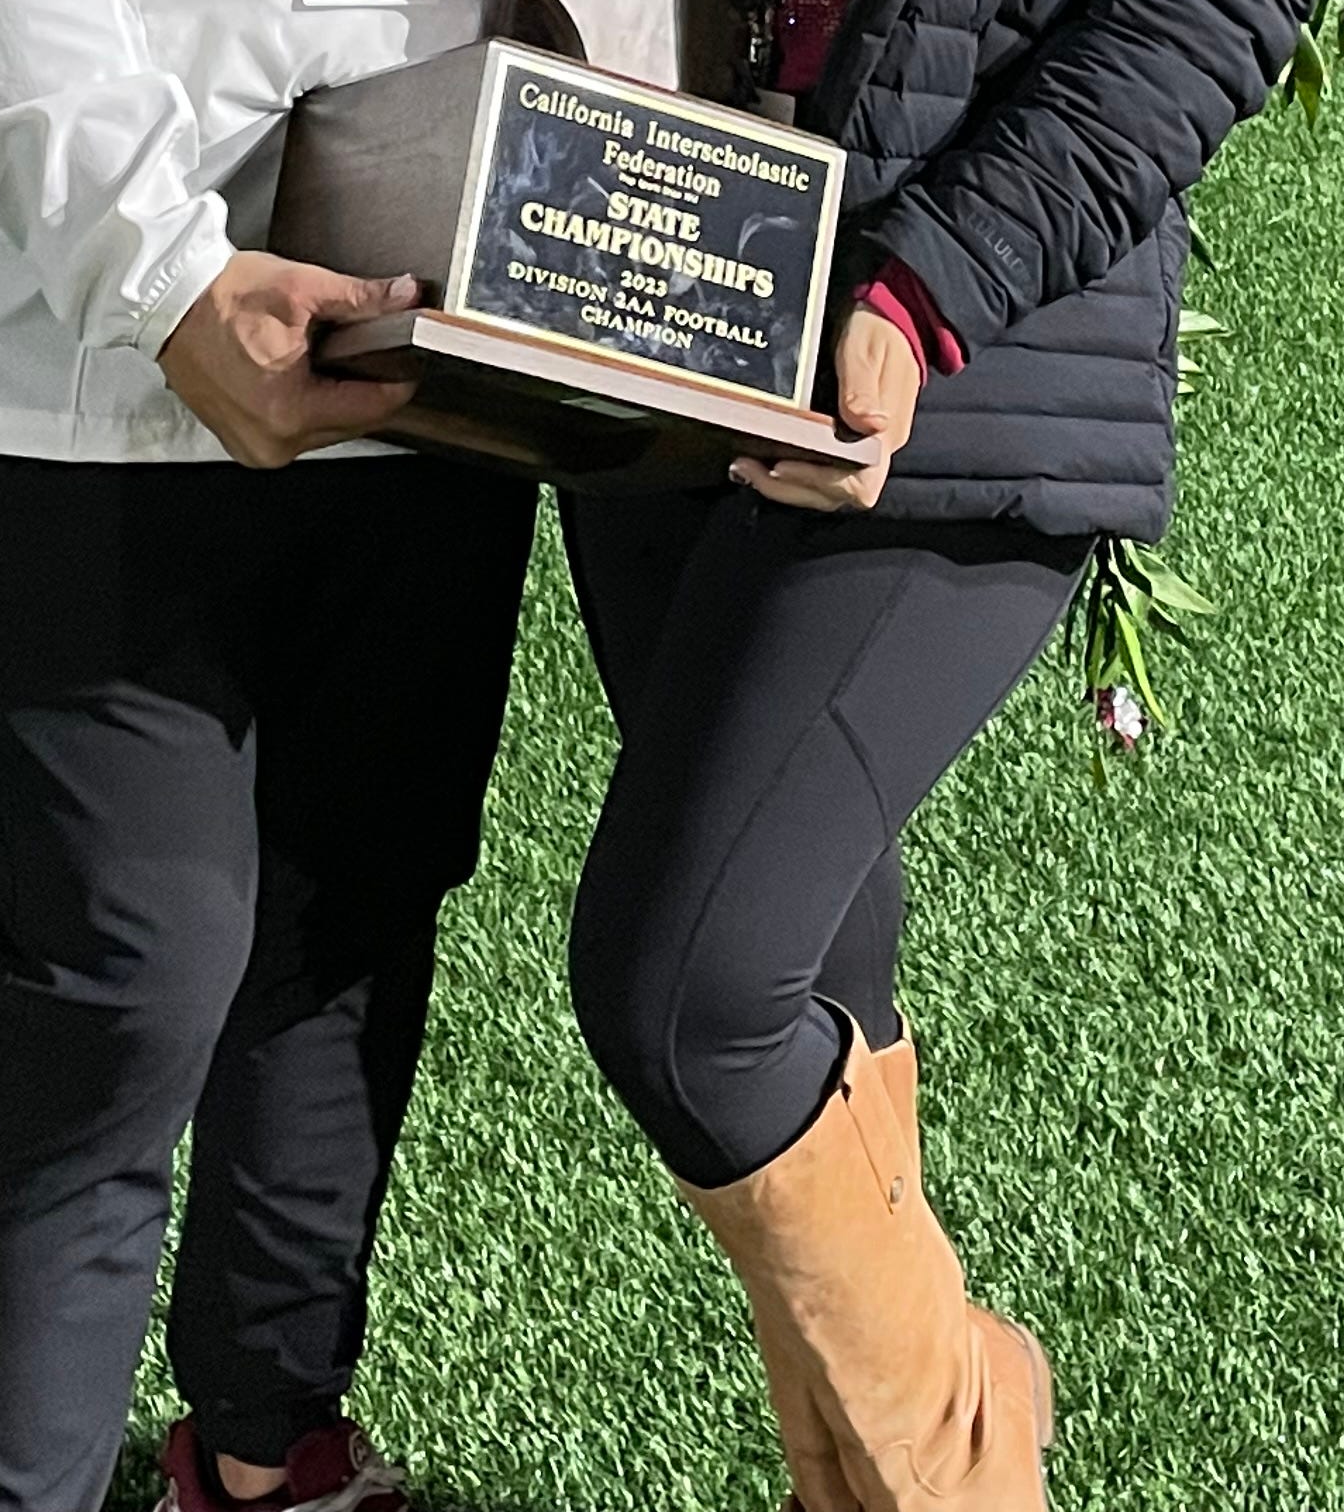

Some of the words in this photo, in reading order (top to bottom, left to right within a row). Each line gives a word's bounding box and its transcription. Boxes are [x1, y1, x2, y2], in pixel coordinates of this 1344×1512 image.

[519, 82, 635, 140] California
[647, 120, 811, 192] Interscholastic
[603, 140, 722, 198] Federation
[606, 191, 702, 242] STATE
[519, 202, 775, 299] CHAMPIONSHIPS
[508, 261, 608, 303] DIVISION
[662, 306, 769, 350] FOOTBALL
[620, 270, 669, 298] 2023
[580, 304, 695, 351] CHAMPION
